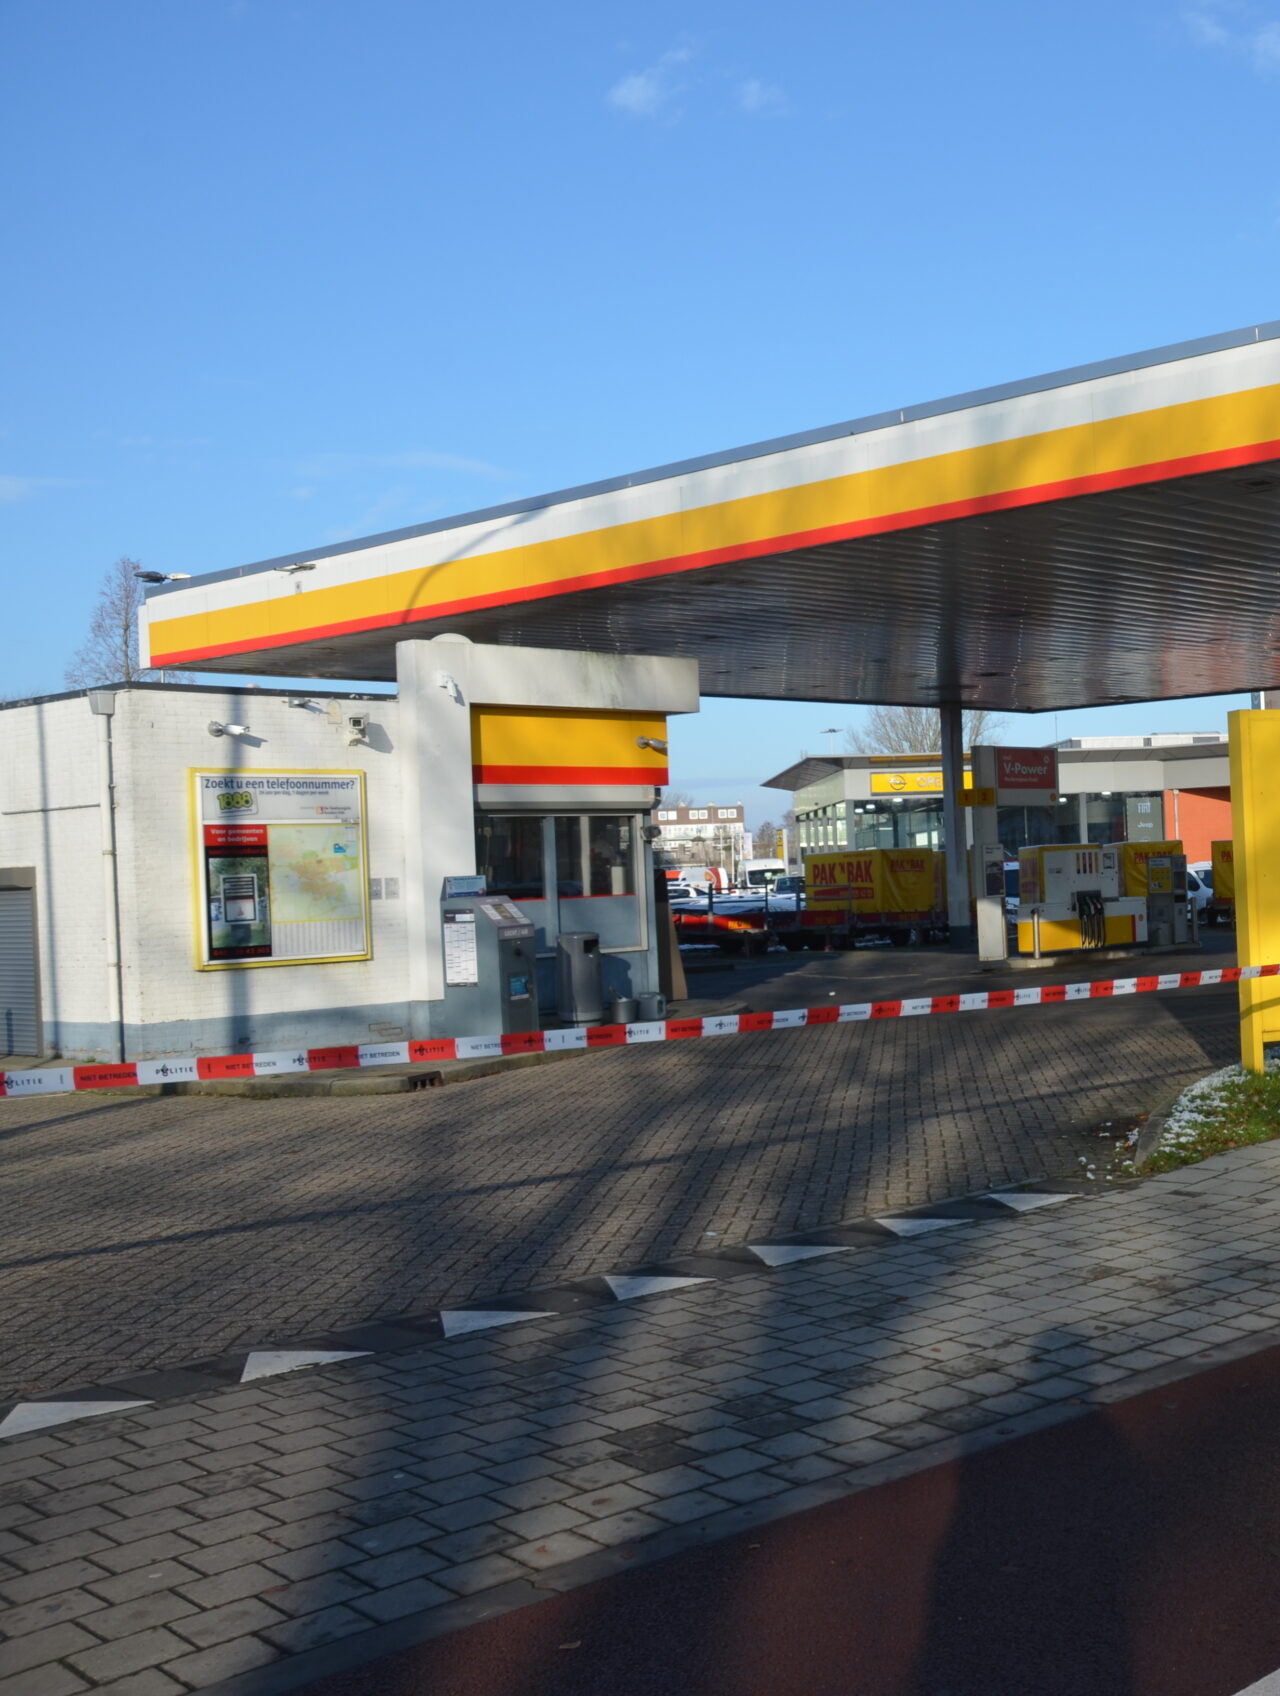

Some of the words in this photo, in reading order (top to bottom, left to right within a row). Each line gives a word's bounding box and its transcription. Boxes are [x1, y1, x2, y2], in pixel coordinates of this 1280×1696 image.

[1003, 762, 1049, 776] V-Power
[205, 778, 234, 789] Zoekt
[236, 780, 243, 789] u
[245, 780, 264, 789] een
[267, 778, 355, 790] telefoonnummer?
[916, 776, 942, 788] OPE
[216, 791, 253, 811] 1888
[813, 863, 837, 885] PAK
[847, 859, 873, 883] BAK
[155, 1064, 193, 1077] POLITIE
[241, 1060, 277, 1069] BETREDEN
[98, 1072, 138, 1081] BETREDEN
